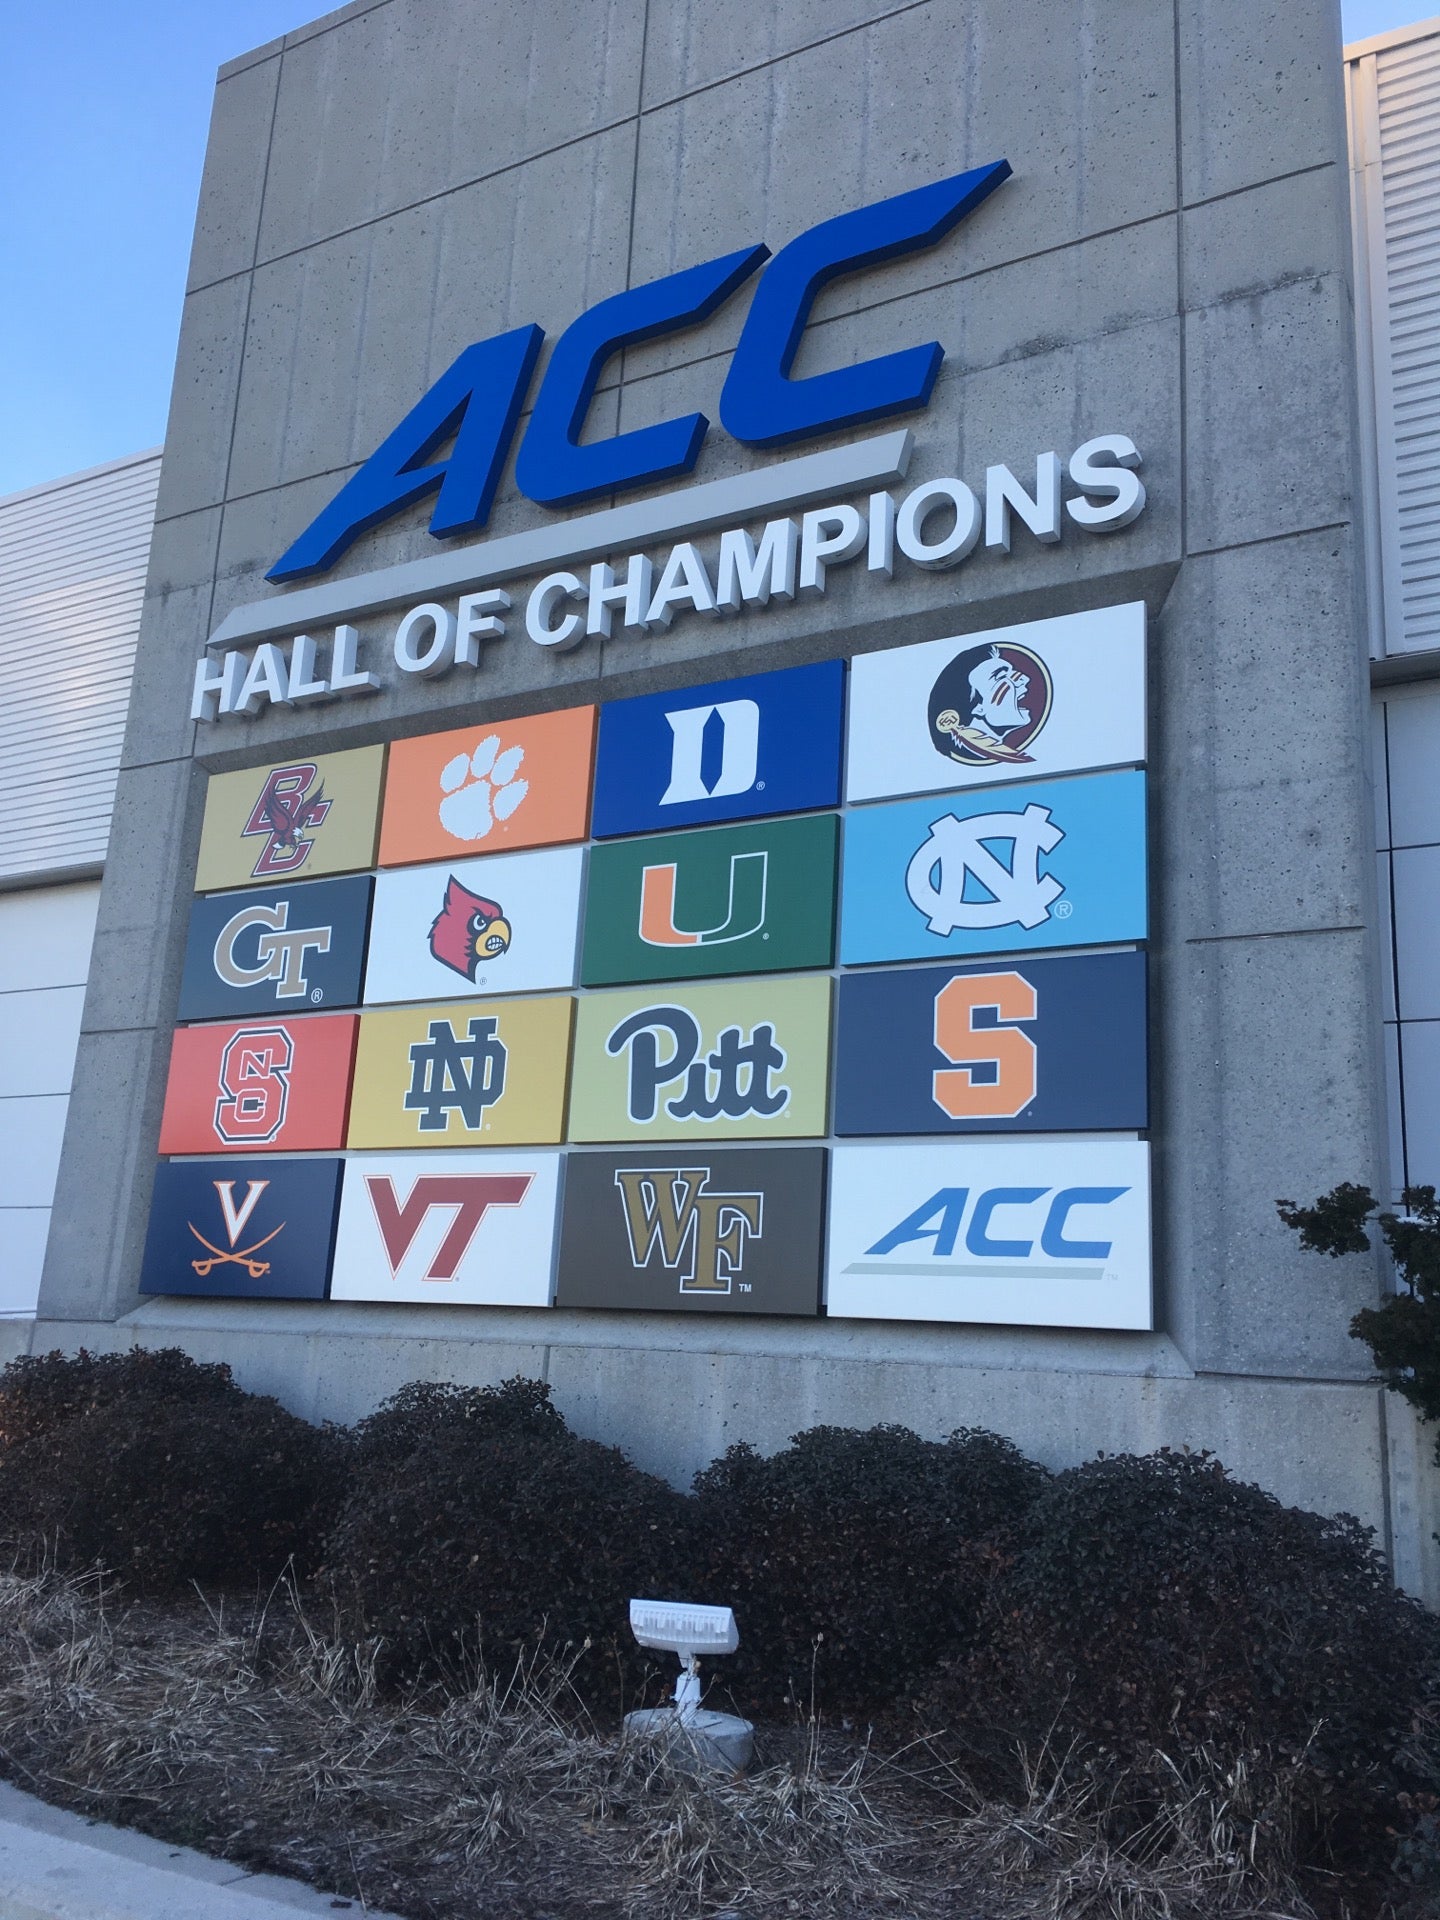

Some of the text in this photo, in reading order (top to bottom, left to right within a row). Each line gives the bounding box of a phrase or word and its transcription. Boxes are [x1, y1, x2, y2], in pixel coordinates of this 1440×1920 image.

[265, 159, 1013, 584] ACC
[192, 433, 1147, 725] HALL OF CHAMPIONS
[605, 1003, 791, 1123] Pitt
[932, 970, 1038, 1119] S
[362, 1172, 537, 1281] VT
[614, 1167, 764, 1294] WF
[864, 1186, 1133, 1258] ACC
